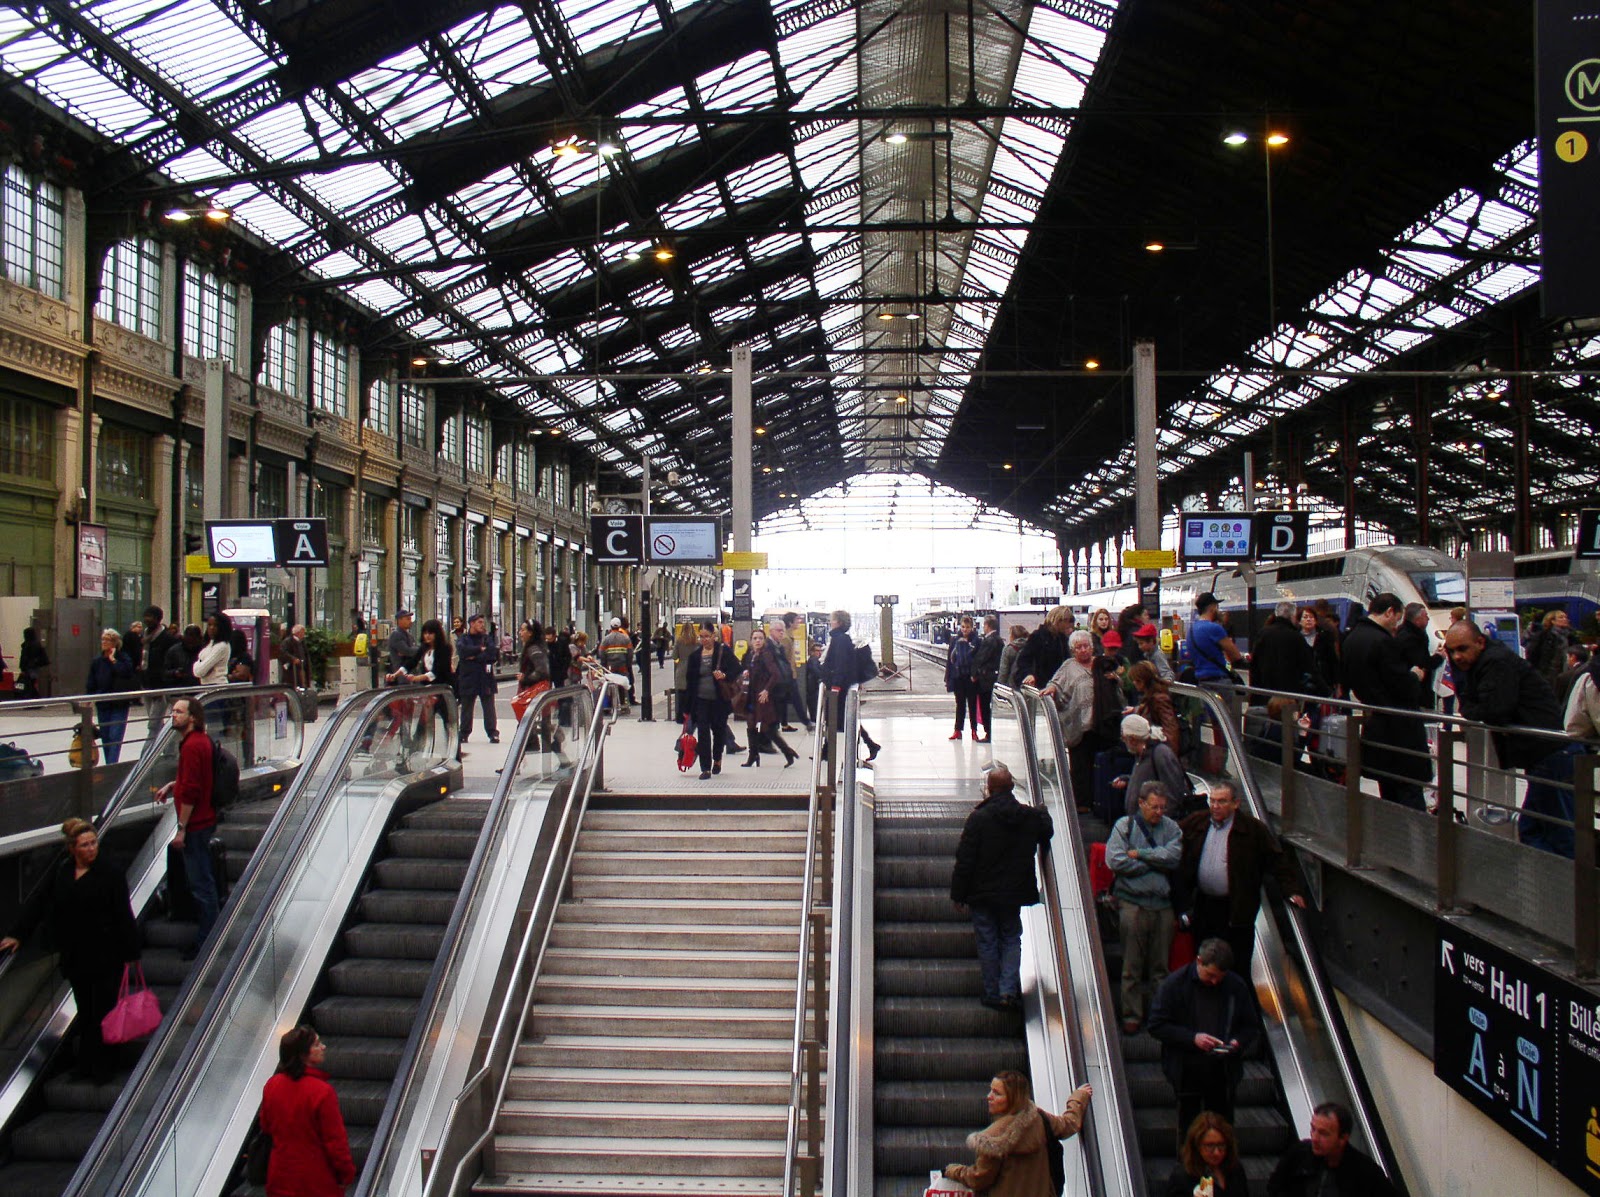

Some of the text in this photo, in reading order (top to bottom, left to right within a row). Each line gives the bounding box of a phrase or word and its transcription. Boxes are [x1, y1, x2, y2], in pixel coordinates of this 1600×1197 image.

[1578, 71, 1600, 100] M
[1565, 138, 1576, 156] 1
[294, 533, 316, 558] A
[606, 530, 628, 555] C
[1271, 526, 1294, 551] D
[1463, 952, 1546, 1029] vers Hall 1
[1468, 1032, 1487, 1086] A
[1519, 1040, 1537, 1060] Voie
[1497, 1052, 1505, 1078] à
[1518, 1059, 1539, 1121] N
